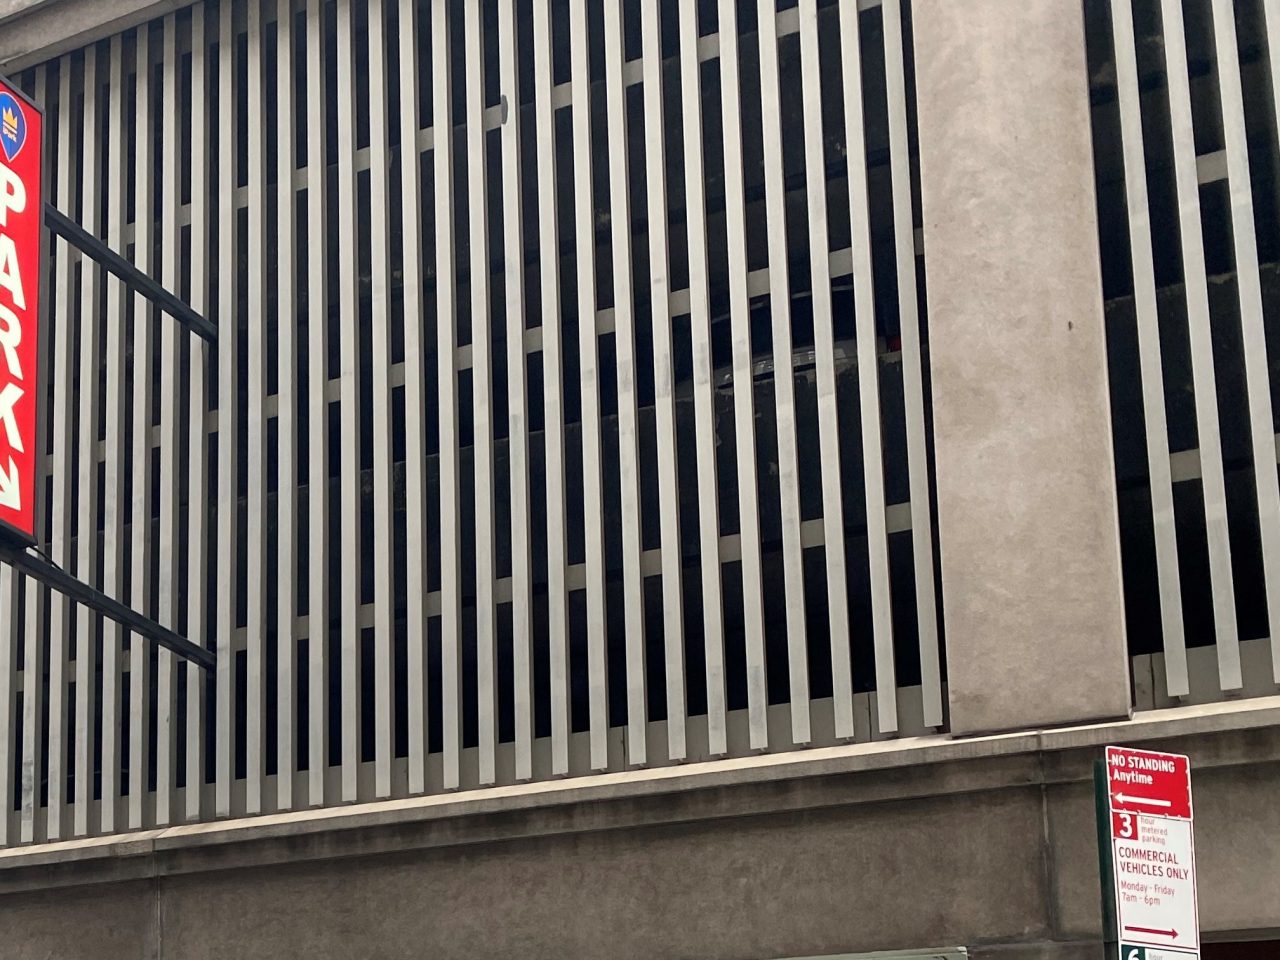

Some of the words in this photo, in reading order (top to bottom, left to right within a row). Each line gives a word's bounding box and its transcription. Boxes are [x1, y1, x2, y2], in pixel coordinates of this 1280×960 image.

[1111, 754, 1125, 767] NO
[1128, 756, 1175, 773] STANDING
[1114, 769, 1153, 784] Anytime
[1119, 814, 1133, 837] 3
[1141, 826, 1168, 835] metered
[1142, 835, 1165, 845] parking
[1119, 847, 1178, 864] COMMERCIAL
[1120, 861, 1163, 877] VEHICLES
[1167, 868, 1188, 880] ONLY
[1121, 880, 1148, 892] Monday
[1154, 884, 1175, 897] Friday
[1122, 892, 1137, 902] 7am
[1144, 895, 1160, 906] 6pm
